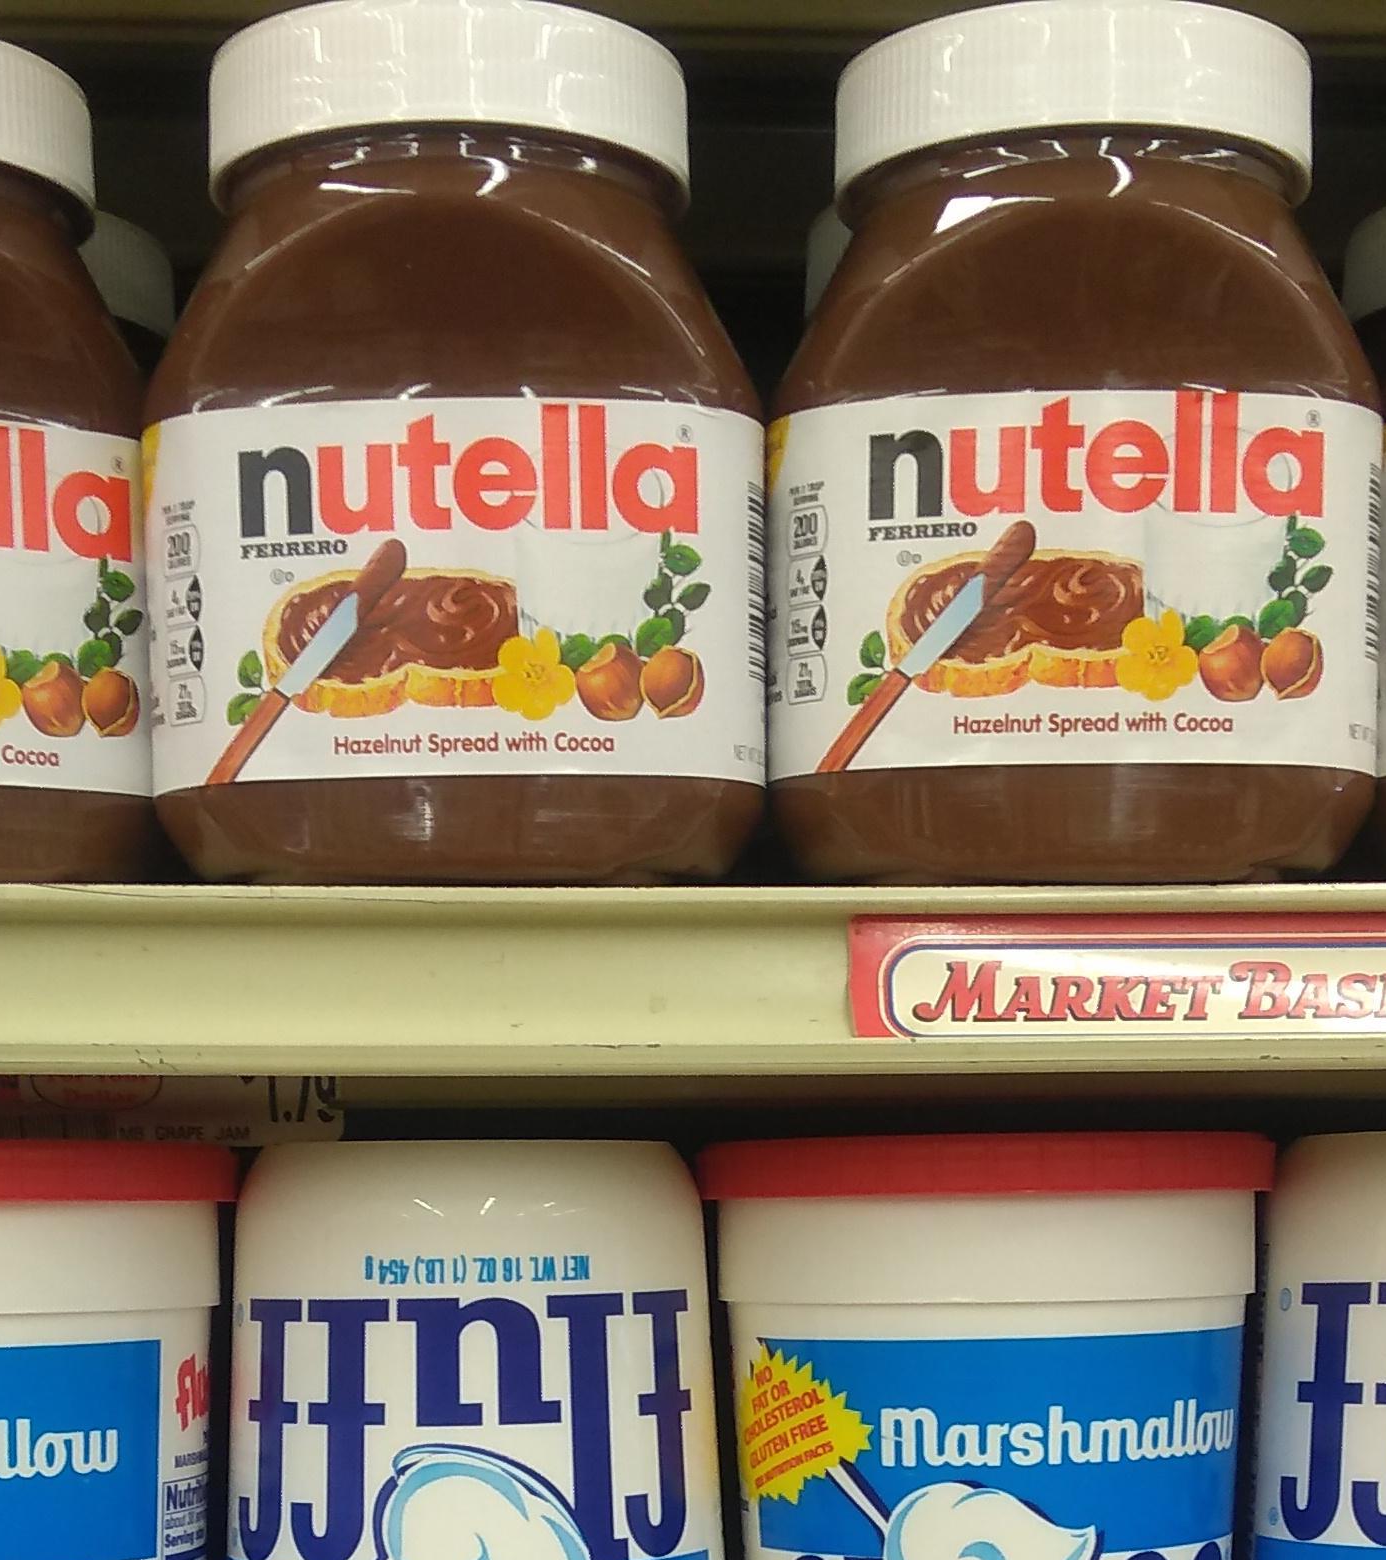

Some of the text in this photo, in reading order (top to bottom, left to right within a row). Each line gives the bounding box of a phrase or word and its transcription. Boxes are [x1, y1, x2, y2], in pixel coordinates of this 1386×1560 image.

[868, 391, 1325, 521] nutella
[238, 403, 699, 537] nutella
[868, 522, 978, 541] FERRERO
[240, 539, 348, 559] FERRERO
[953, 713, 1233, 736] Hazelnut Spread with Cocoa
[1, 744, 60, 767] Cocoa
[913, 960, 1223, 1023] MARKET
[155, 1124, 205, 1140] GRAPE
[215, 1124, 251, 1140] JAM
[377, 1257, 410, 1284] 454
[503, 1256, 524, 1282] 16
[562, 1255, 591, 1280] NET
[755, 1366, 772, 1388] NO
[751, 1380, 790, 1415] FAT OR
[744, 1389, 825, 1445] CHOLESTEROL
[750, 1414, 829, 1469] GLUTEN FREE
[881, 1399, 1235, 1467] Marshmallow
[804, 1441, 834, 1461] FACTS
